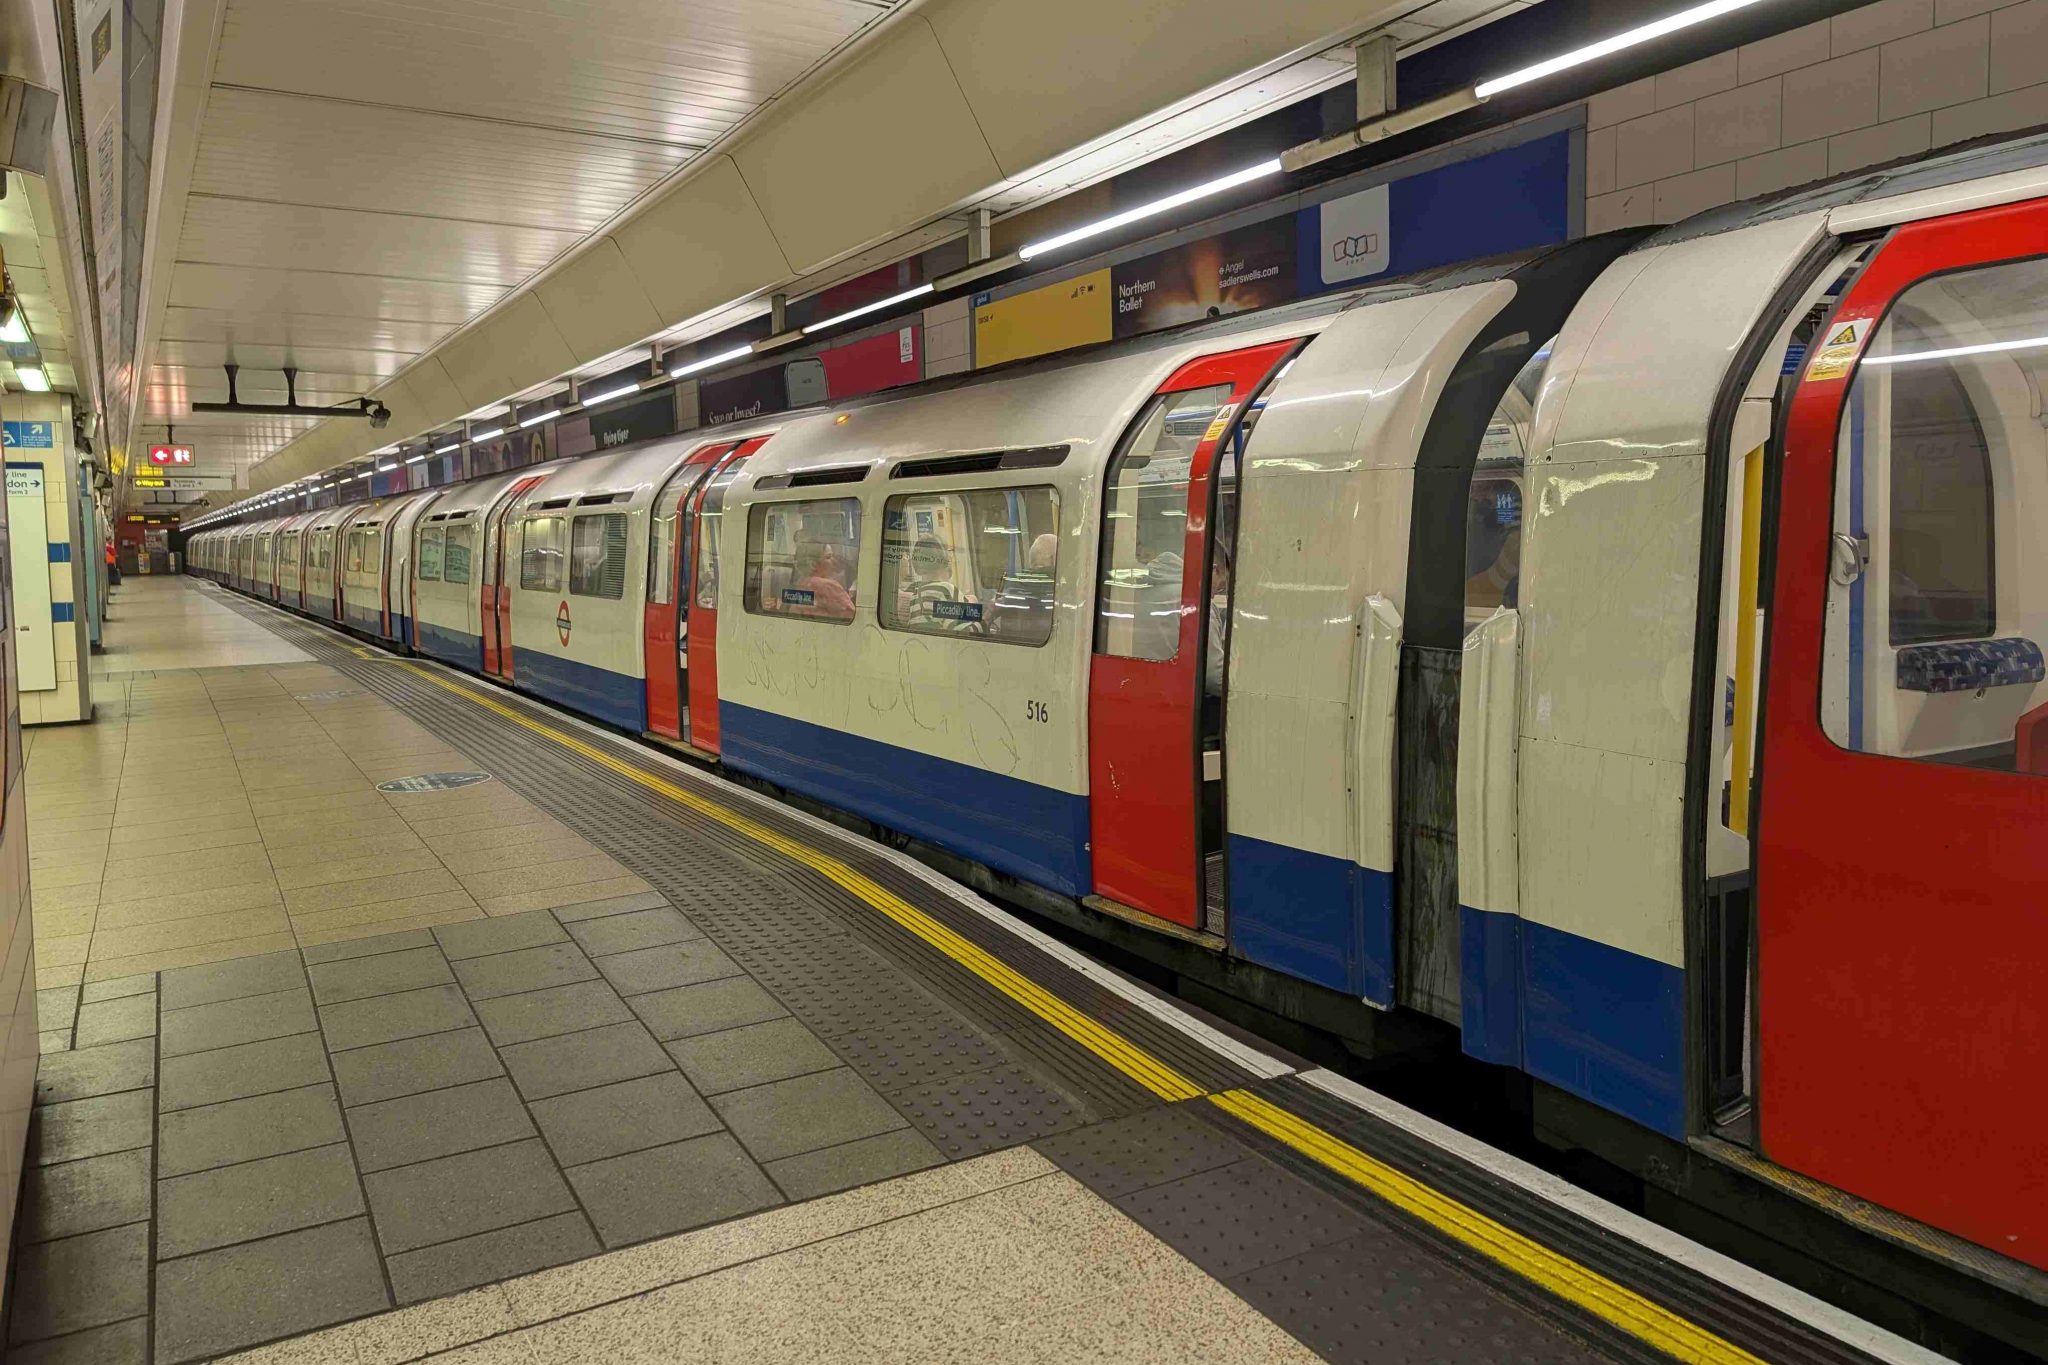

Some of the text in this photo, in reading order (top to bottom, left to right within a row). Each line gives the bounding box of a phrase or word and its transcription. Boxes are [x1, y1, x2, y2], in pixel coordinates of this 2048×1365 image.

[1225, 259, 1244, 274] Angel
[1219, 265, 1279, 289] sadlerswells.com
[1119, 279, 1156, 298] Northern
[1119, 297, 1143, 314] Ballet
[725, 412, 734, 422] or
[734, 400, 761, 420] Invest?
[936, 603, 979, 619] Piccadilly line
[1026, 699, 1048, 723] 516
